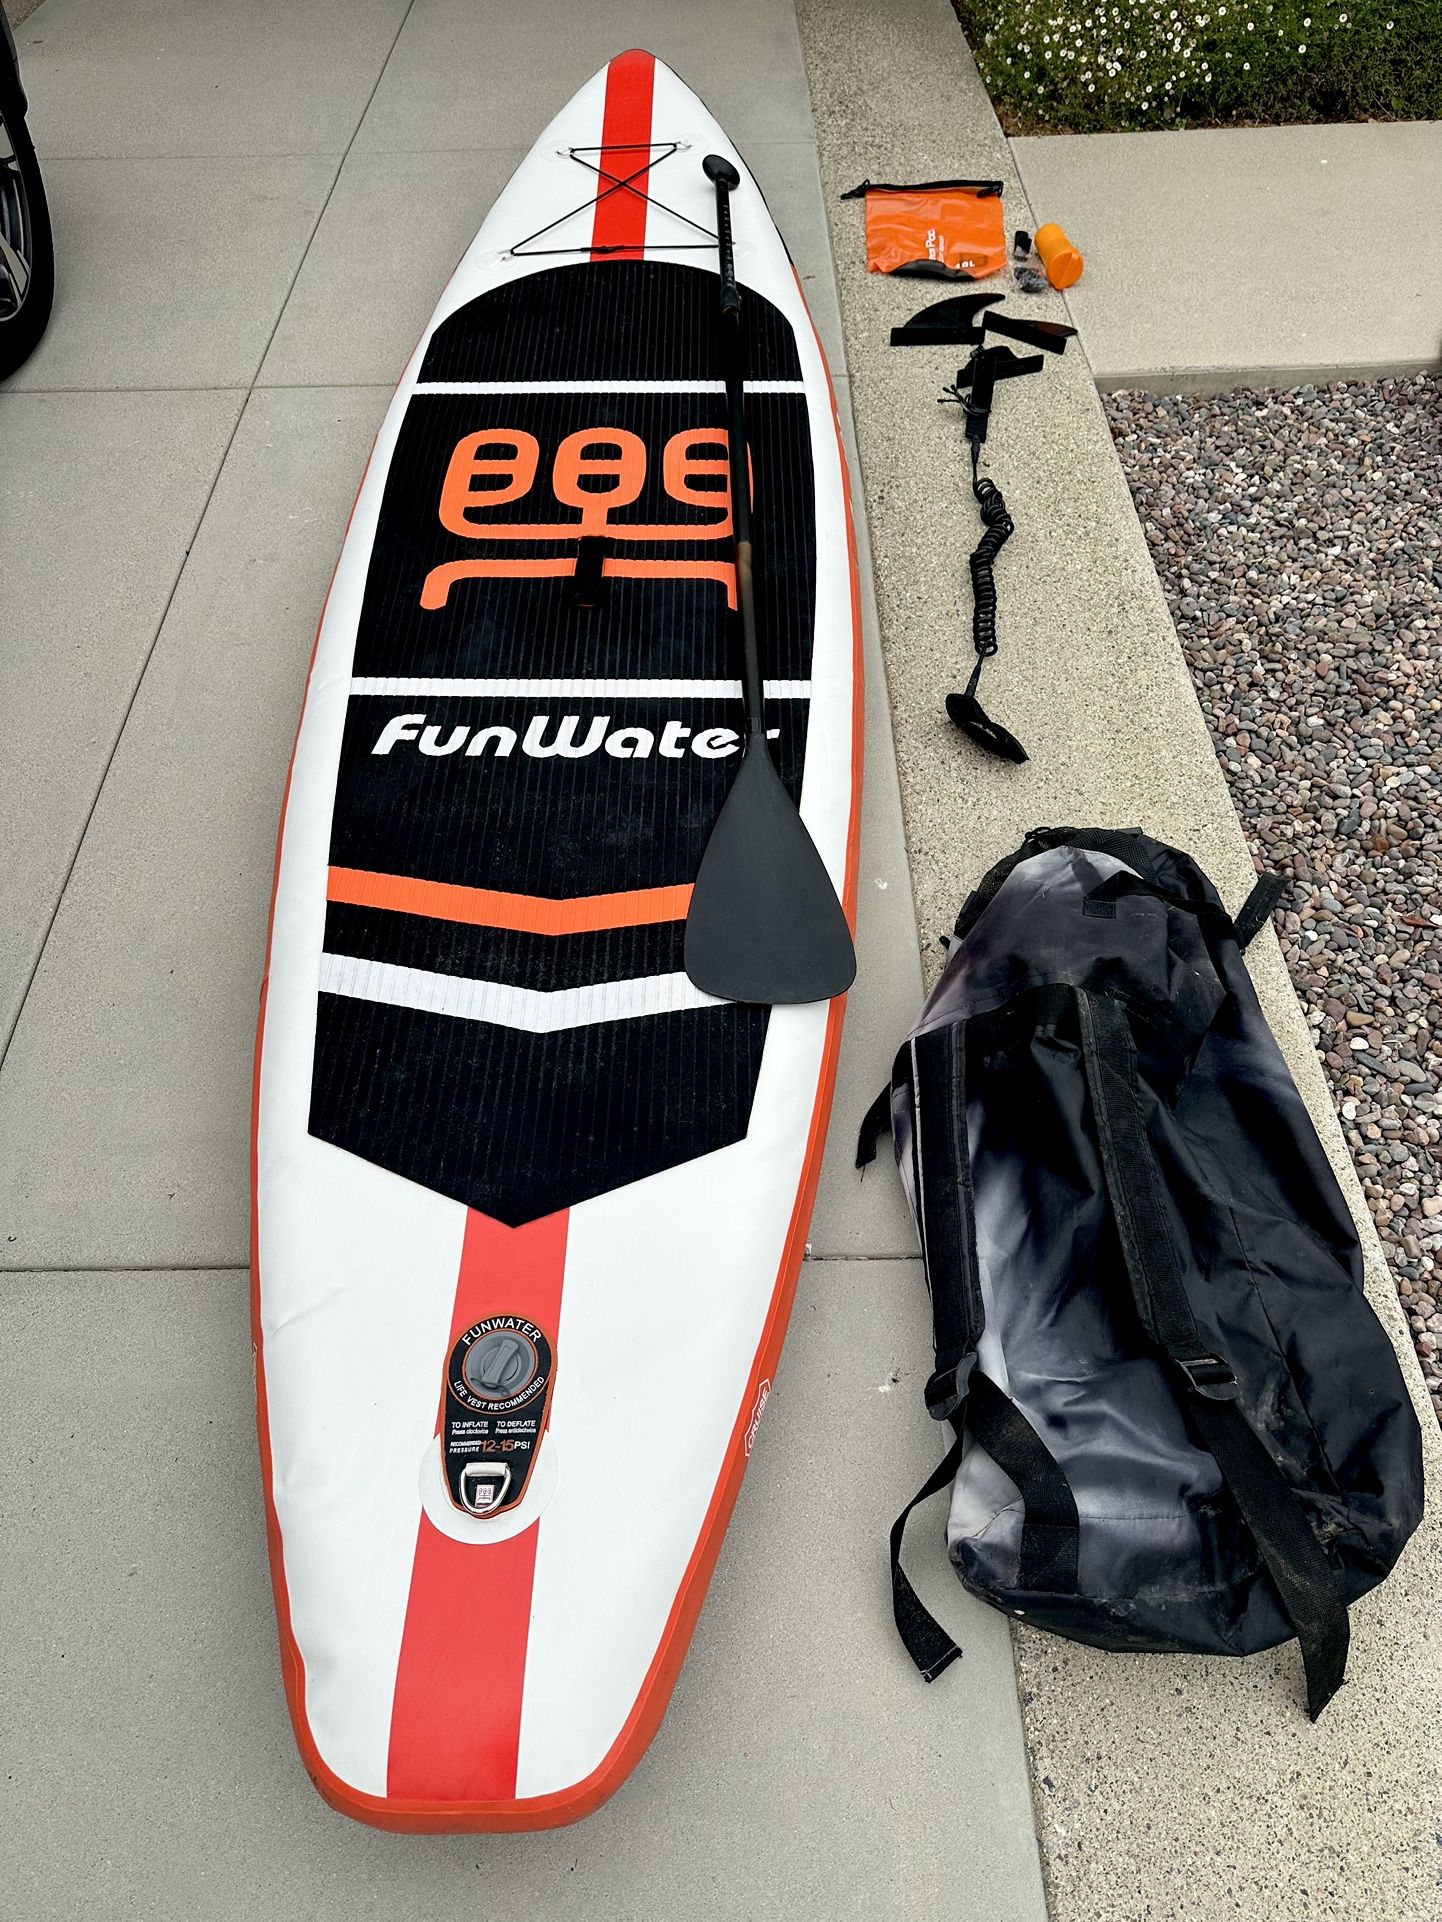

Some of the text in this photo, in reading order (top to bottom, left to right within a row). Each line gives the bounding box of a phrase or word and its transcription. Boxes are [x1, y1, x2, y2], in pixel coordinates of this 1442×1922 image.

[462, 1317, 542, 1346] FUNWATER
[453, 1376, 545, 1411] LIFE VEST RECOMMENDED
[451, 1421, 462, 1429] TO
[496, 1420, 536, 1428] TO DEFLATE
